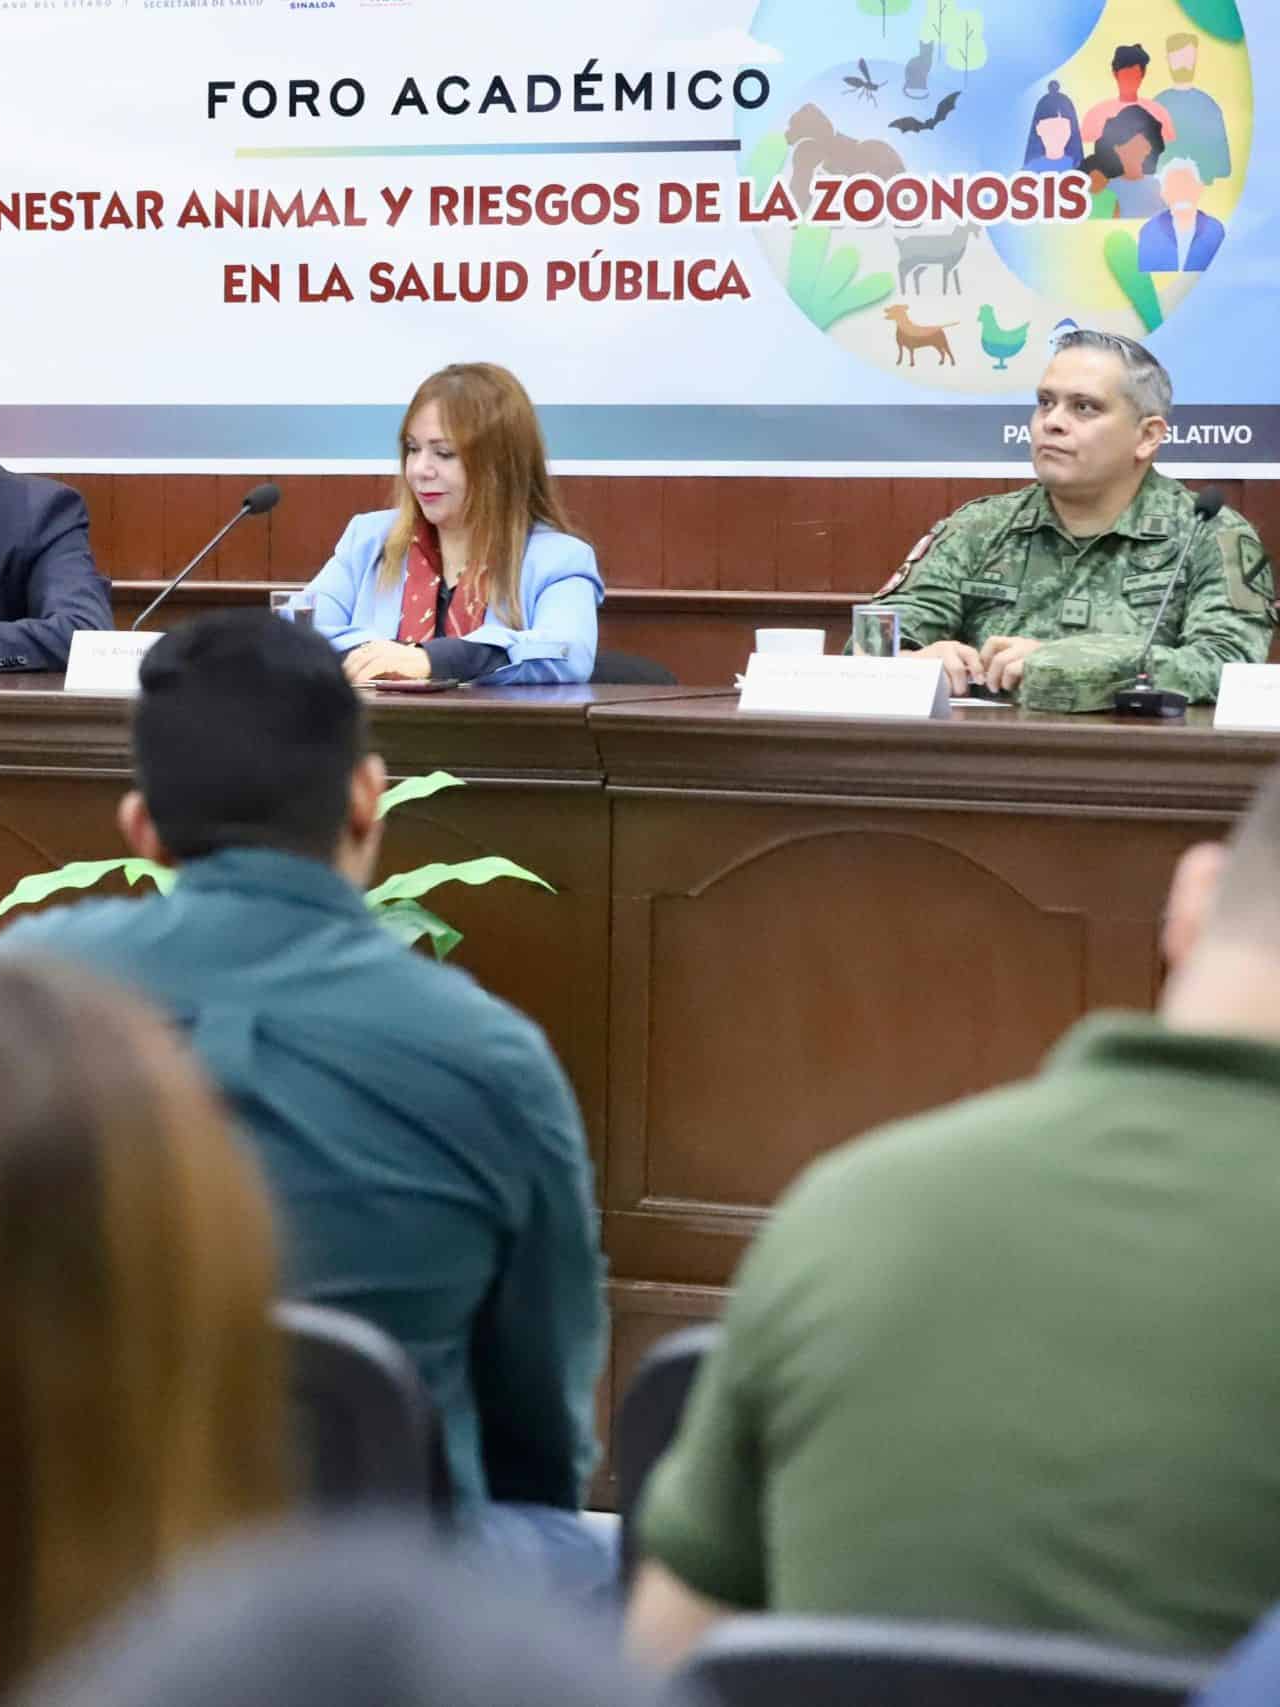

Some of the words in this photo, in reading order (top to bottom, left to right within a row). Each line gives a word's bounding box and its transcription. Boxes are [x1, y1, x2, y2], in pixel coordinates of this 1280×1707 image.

[289, 1, 337, 9] SINALOA
[208, 78, 365, 119] FORO
[392, 59, 770, 116] ACADÉMICO
[177, 187, 366, 229] ANIMAL
[381, 187, 413, 226] Y
[431, 183, 639, 225] RIESGOS
[660, 182, 720, 224] DE
[741, 183, 795, 222] LA
[813, 175, 1088, 222] ZOONOSIS
[224, 264, 280, 303] EN
[300, 263, 353, 302] LA
[371, 261, 528, 303] SALUD
[547, 250, 751, 301] PÚBLICA
[1003, 424, 1032, 444] PA
[1160, 424, 1253, 444] SLATIVO
